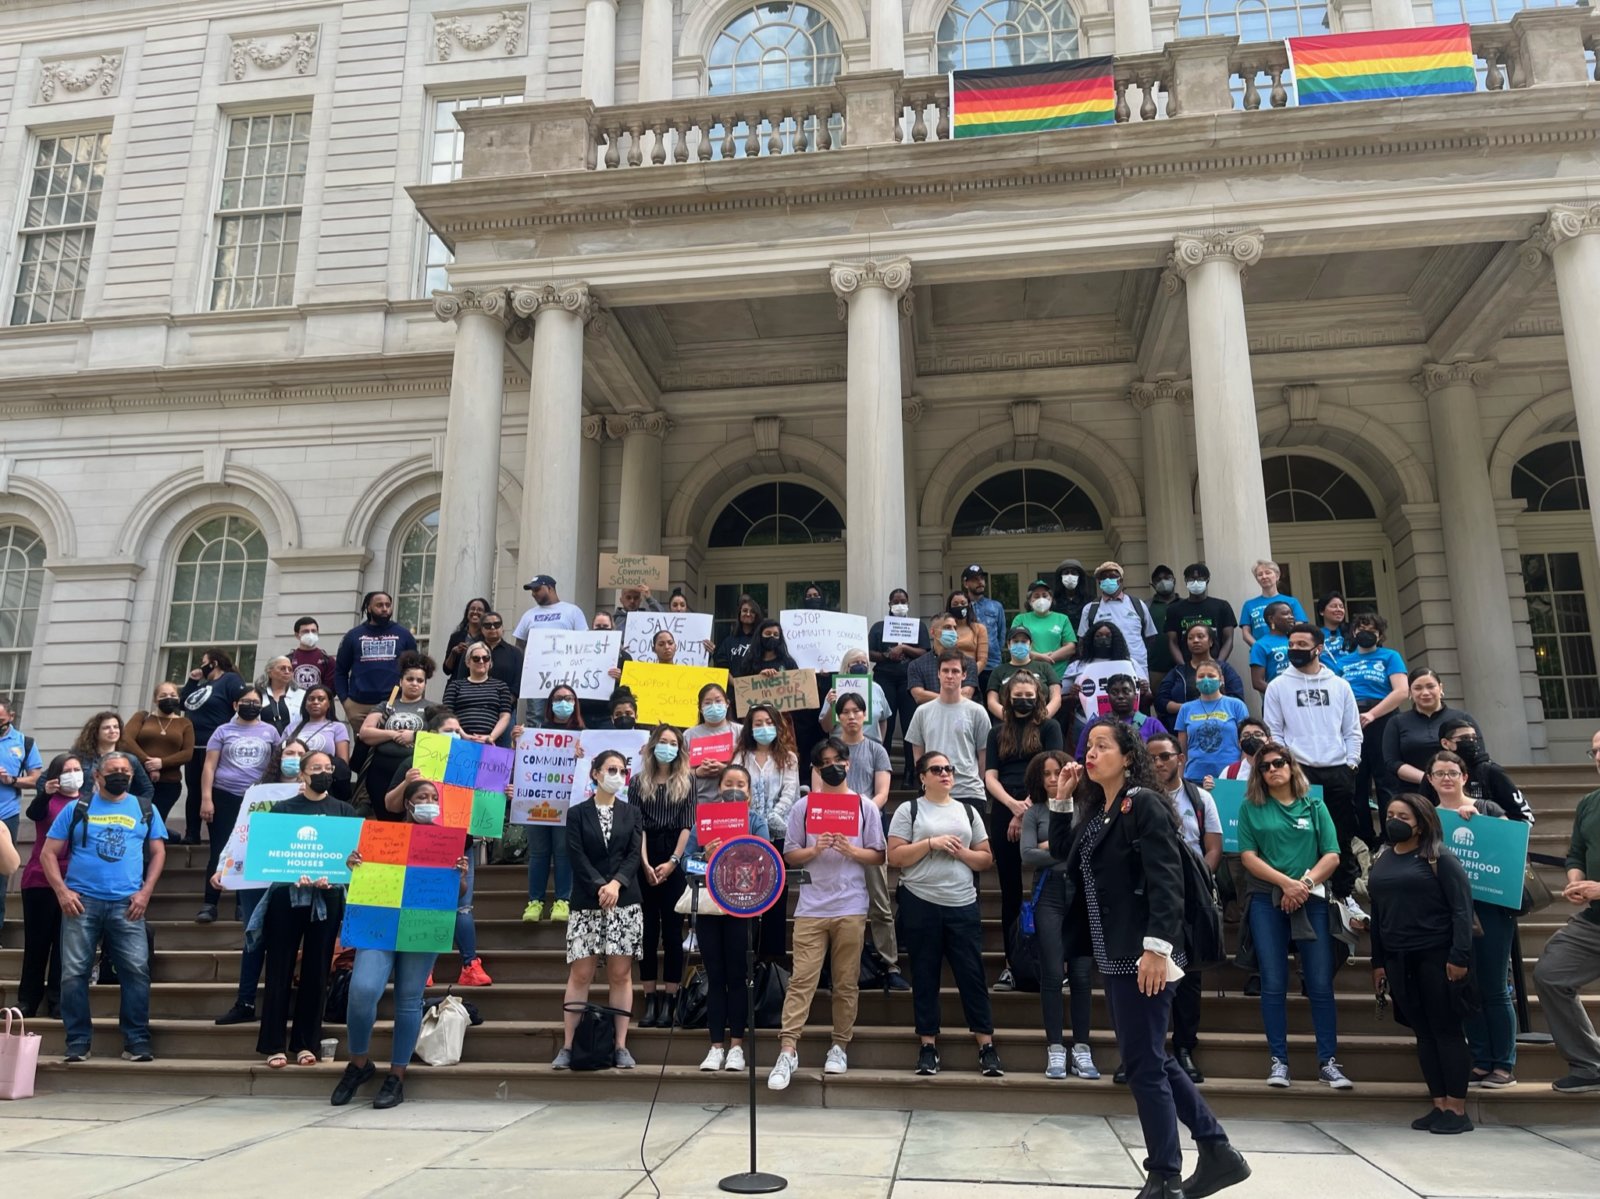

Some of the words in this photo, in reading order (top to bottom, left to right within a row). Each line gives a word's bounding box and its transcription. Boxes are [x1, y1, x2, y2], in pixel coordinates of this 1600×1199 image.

[612, 554, 648, 569] Support
[618, 565, 660, 579] Community
[608, 575, 647, 585] Schools
[642, 616, 687, 634] SAVE
[793, 612, 821, 626] STOP
[751, 671, 790, 691] Invest
[838, 679, 861, 688] SAVE
[534, 733, 573, 748] STOP
[416, 737, 453, 762] Save
[454, 750, 512, 782] Community
[525, 772, 574, 784] SCHOOLS
[517, 788, 553, 798] BUDGET
[268, 850, 343, 859] NEIGHBORHOOD
[287, 859, 324, 867] HOUSES
